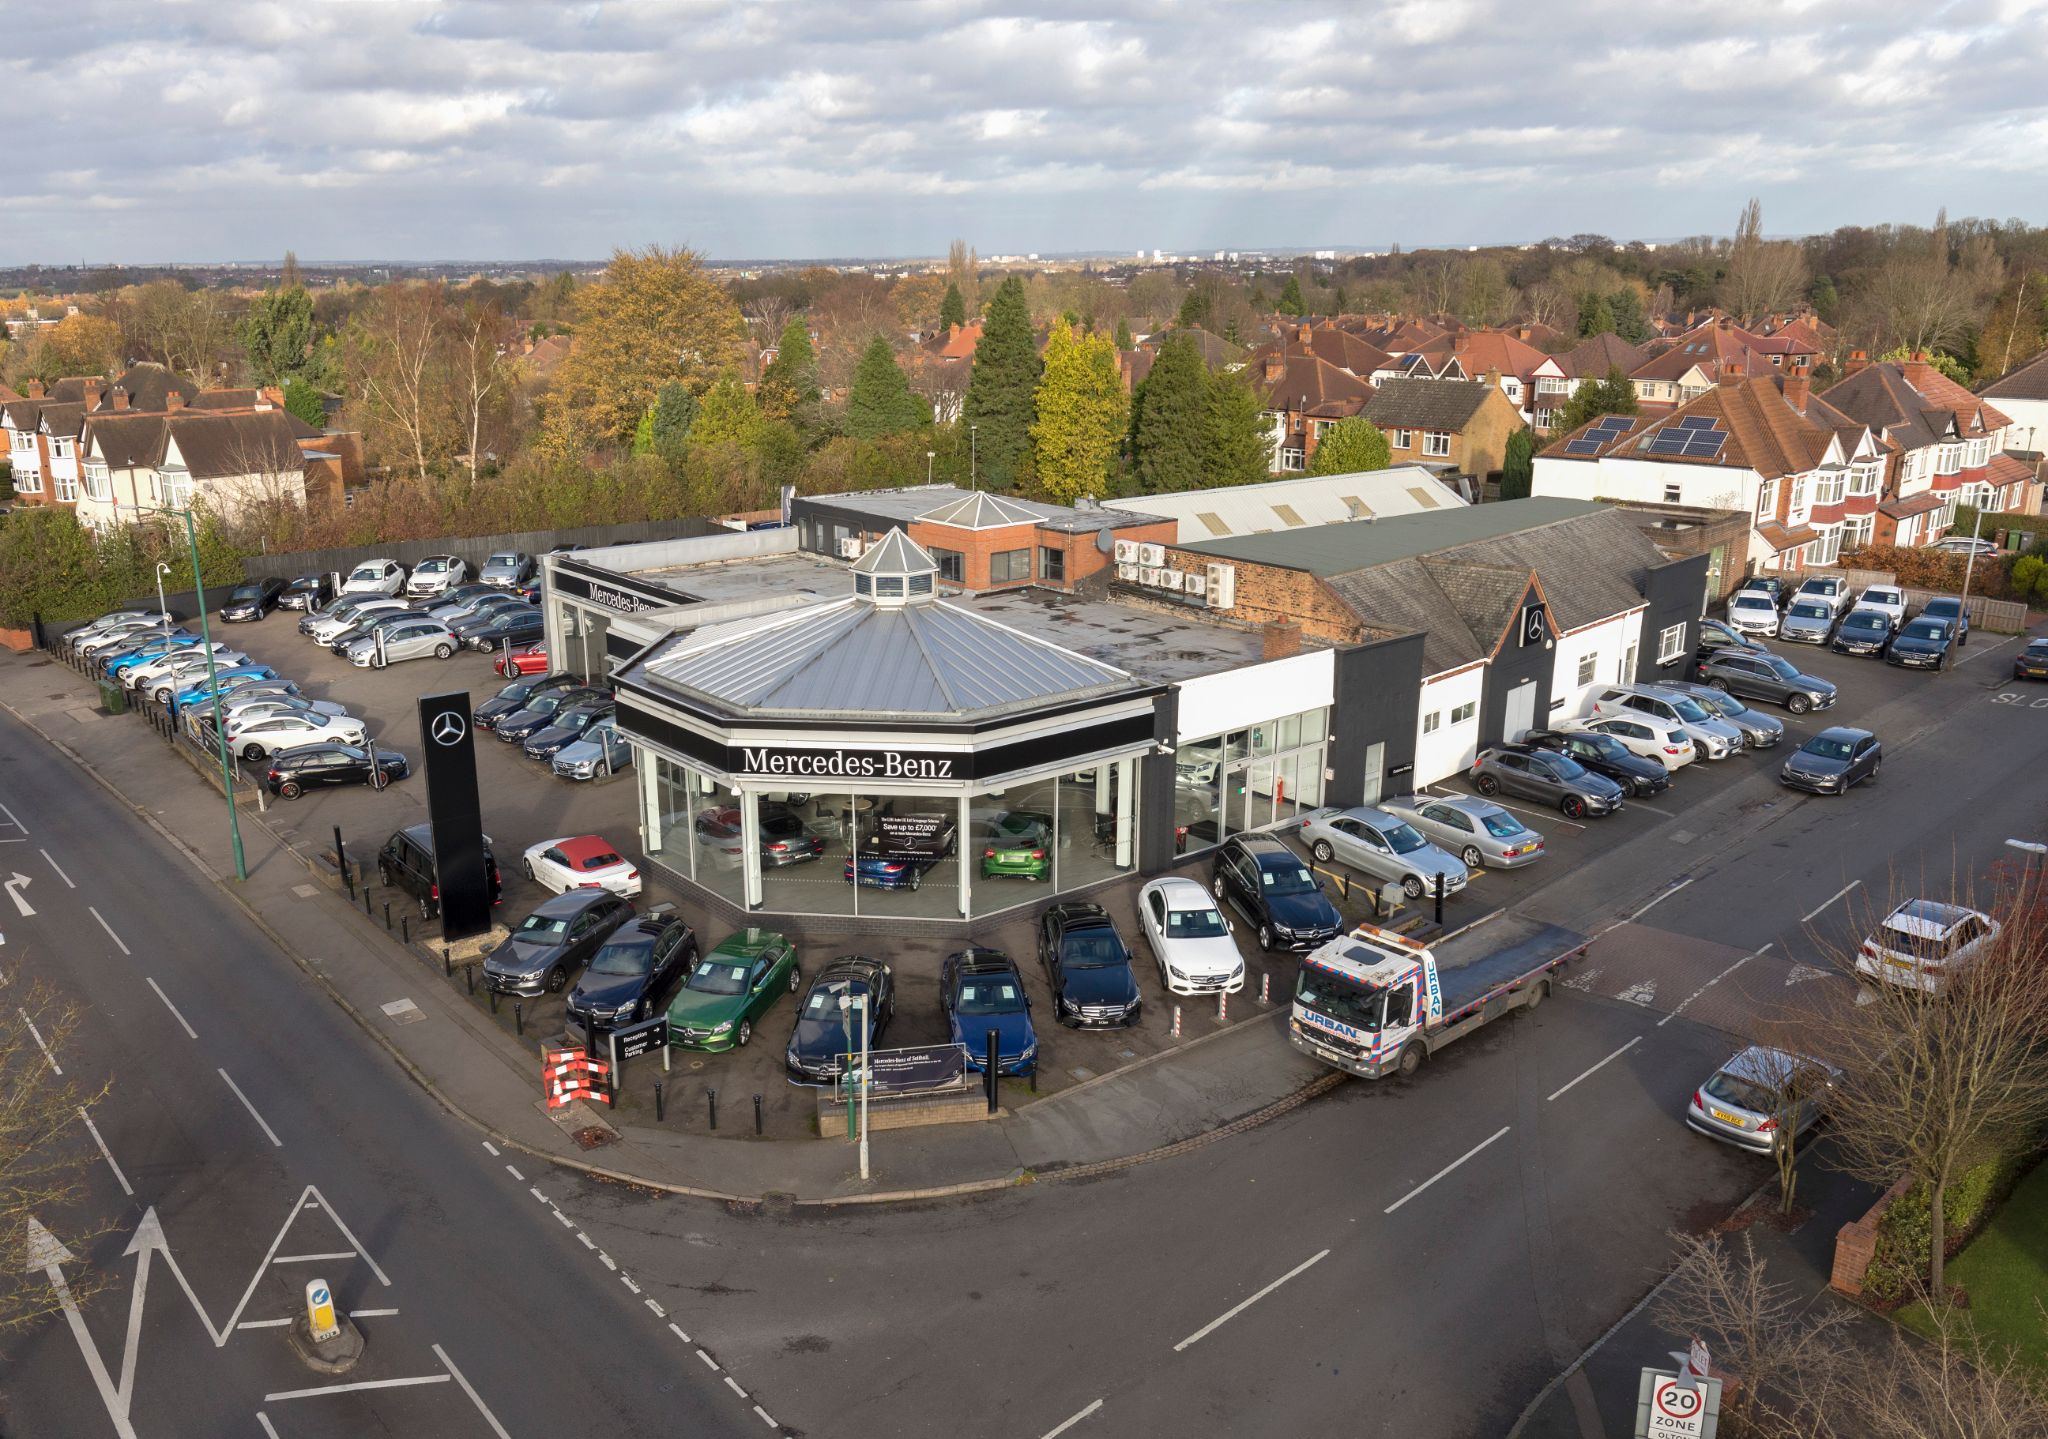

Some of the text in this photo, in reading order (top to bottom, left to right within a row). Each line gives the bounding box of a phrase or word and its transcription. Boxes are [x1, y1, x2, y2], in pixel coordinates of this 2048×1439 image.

[742, 747, 953, 778] Mercedes-Benz
[1428, 961, 1441, 1018] URBAN
[1304, 1010, 1357, 1039] URBAN
[623, 1031, 648, 1043] Reception
[624, 1041, 648, 1053] Customer
[624, 1048, 643, 1058] Parking
[874, 1056, 906, 1065] Mercedes-Benz
[1664, 1391, 1695, 1409] 20
[1656, 1416, 1695, 1432] ZONE
